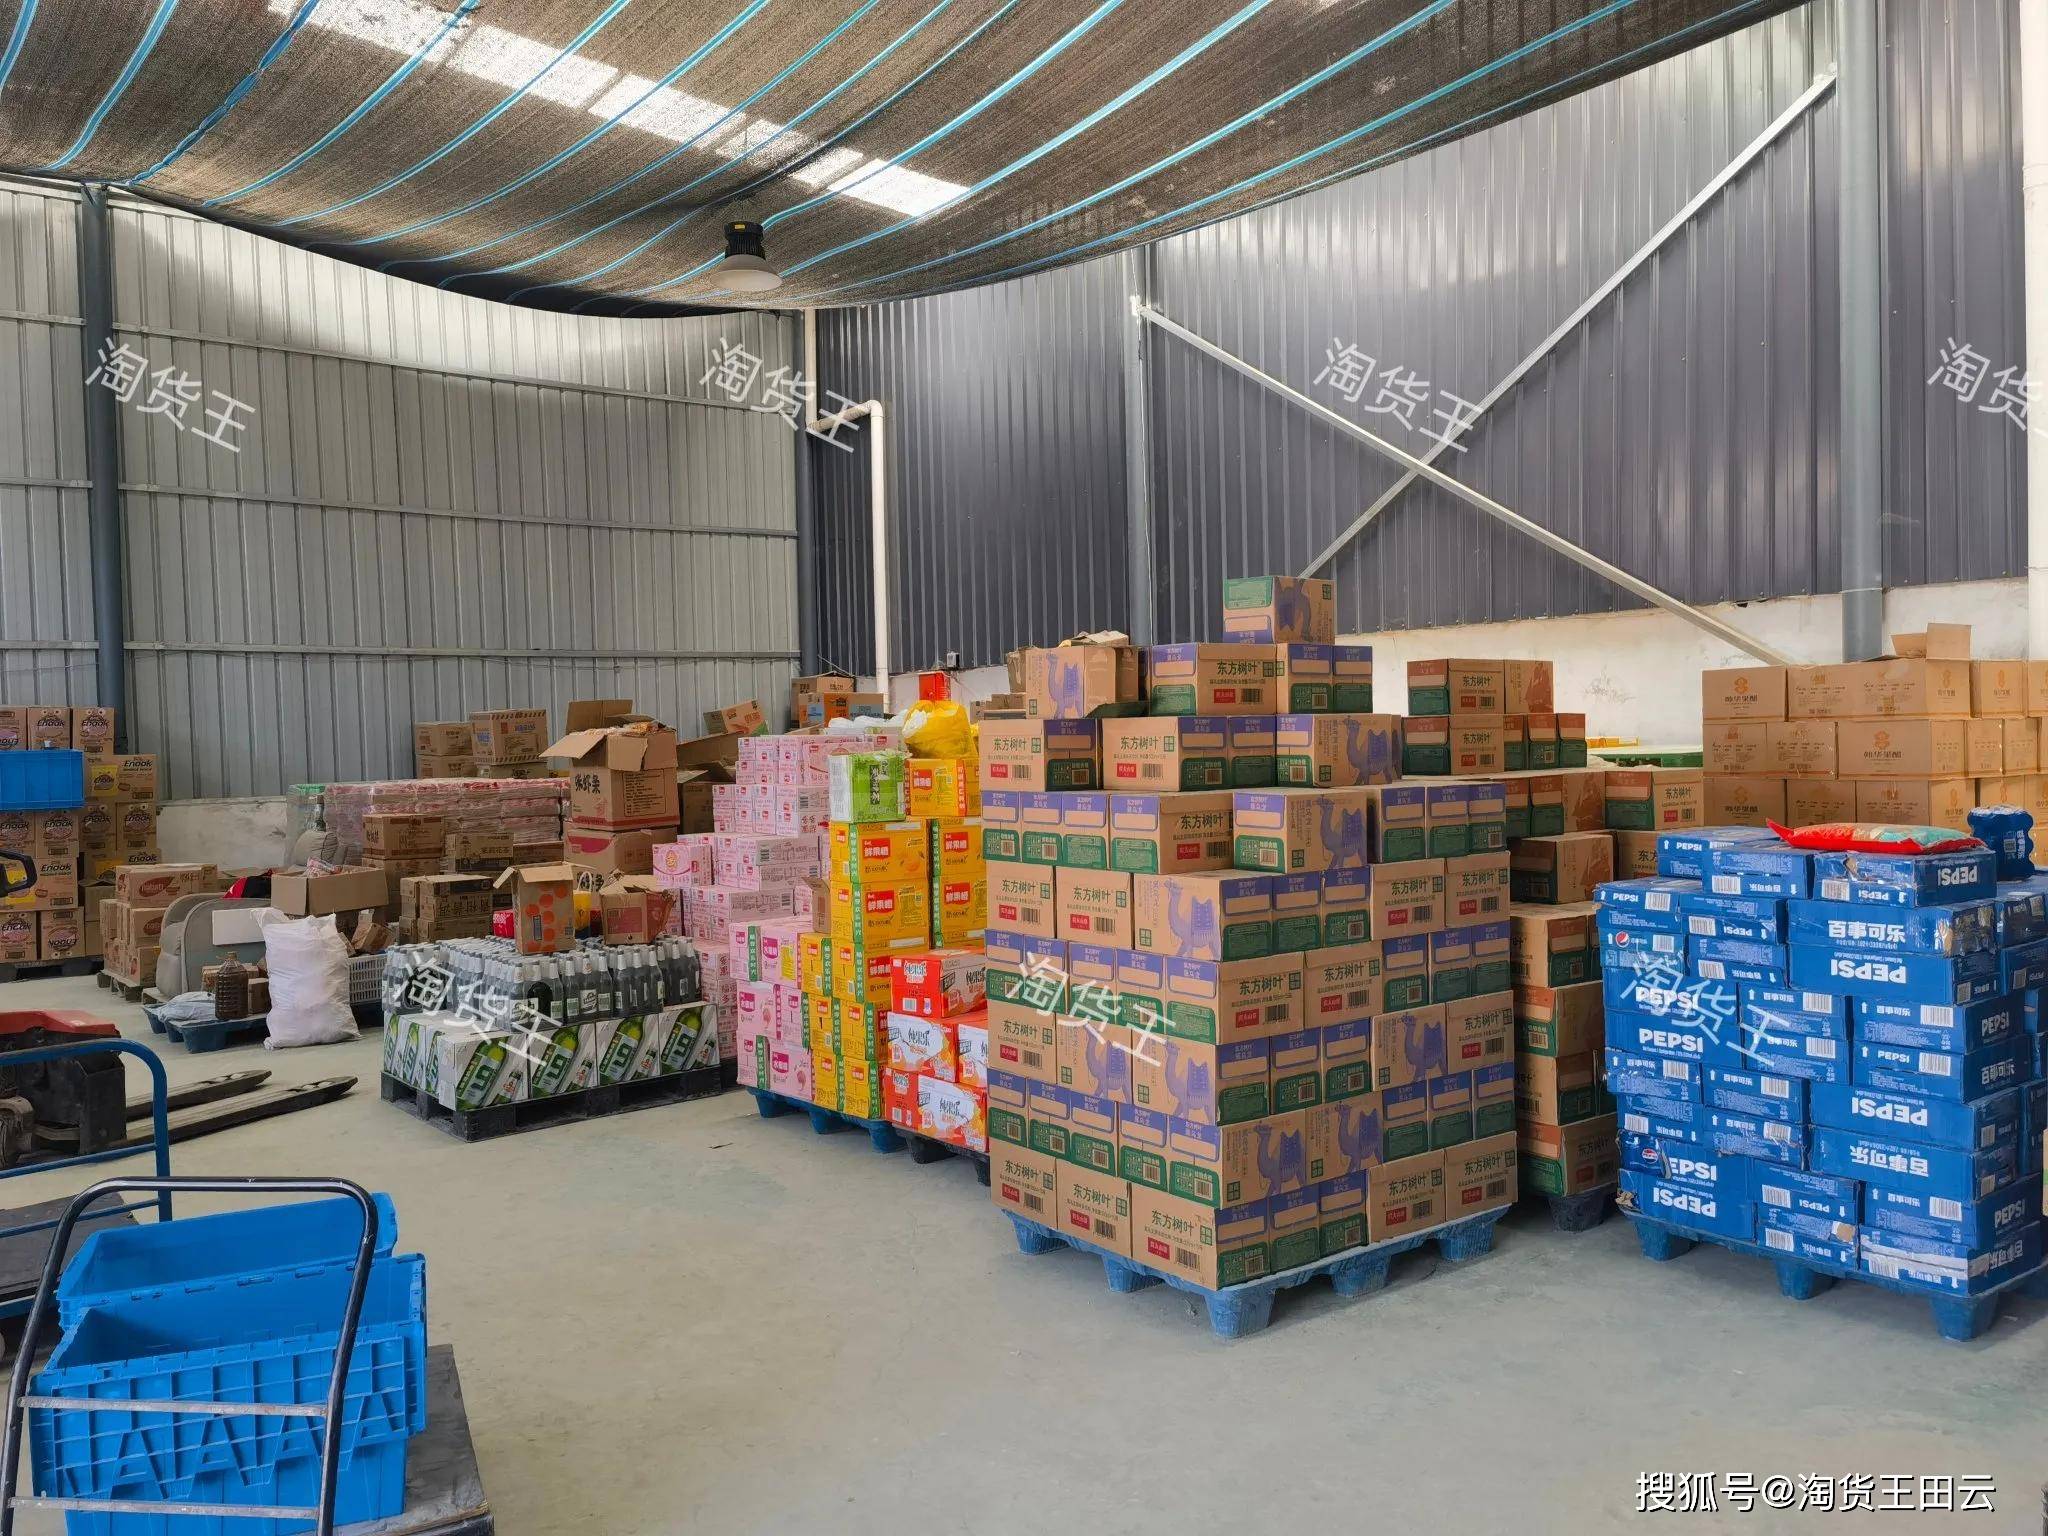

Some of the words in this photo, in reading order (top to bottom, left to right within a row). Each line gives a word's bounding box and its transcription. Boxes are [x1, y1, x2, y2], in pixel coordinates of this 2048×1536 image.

[1217, 659, 1258, 676] 东方树叶
[1462, 675, 1491, 688] 东方树叶
[993, 737, 1028, 751] 东方树叶
[1120, 736, 1158, 751] 东方树叶
[1664, 786, 1692, 799] 东方树叶
[1180, 813, 1223, 830] 东方树叶
[1676, 842, 1702, 851] PEPSI
[1462, 870, 1494, 886] 东方树叶
[1937, 865, 1978, 886] PEPSI
[1002, 879, 1037, 894] 东方树叶
[1073, 887, 1111, 904] 东方树叶
[1391, 880, 1428, 896] 东方树叶
[1858, 890, 1889, 901] PEPSI
[1612, 892, 1639, 902] PEPSI
[1723, 925, 1752, 937] PEPSI
[1828, 920, 1906, 943] 百事可乐
[1323, 963, 1364, 983] 东方树叶
[1830, 958, 1907, 984] PEPSI
[1239, 976, 1284, 996] 东方树叶
[1876, 1005, 1911, 1017] 百事可乐
[1003, 1020, 1038, 1037] 东方树叶
[1464, 1012, 1501, 1030] 东方树叶
[1981, 1013, 2010, 1037] PEPSI
[1639, 1028, 1704, 1053] PEPSI
[1877, 1050, 1910, 1063] PEPSI
[1981, 1060, 2015, 1085] 百事可乐
[1852, 1097, 1928, 1127] PEPSI
[1464, 1156, 1501, 1177] 东方树叶
[1670, 1156, 1717, 1182] EPSI
[1850, 1145, 1929, 1178] 百事可乐
[1005, 1160, 1039, 1182] 东方树叶
[1073, 1183, 1110, 1204] 东方树叶
[1388, 1175, 1427, 1196] 东方树叶
[1653, 1187, 1716, 1218] PEPSI
[1799, 1199, 1830, 1213] PEPSI
[1151, 1210, 1193, 1236] 东方树叶
[1994, 1200, 2025, 1228] PEPSI
